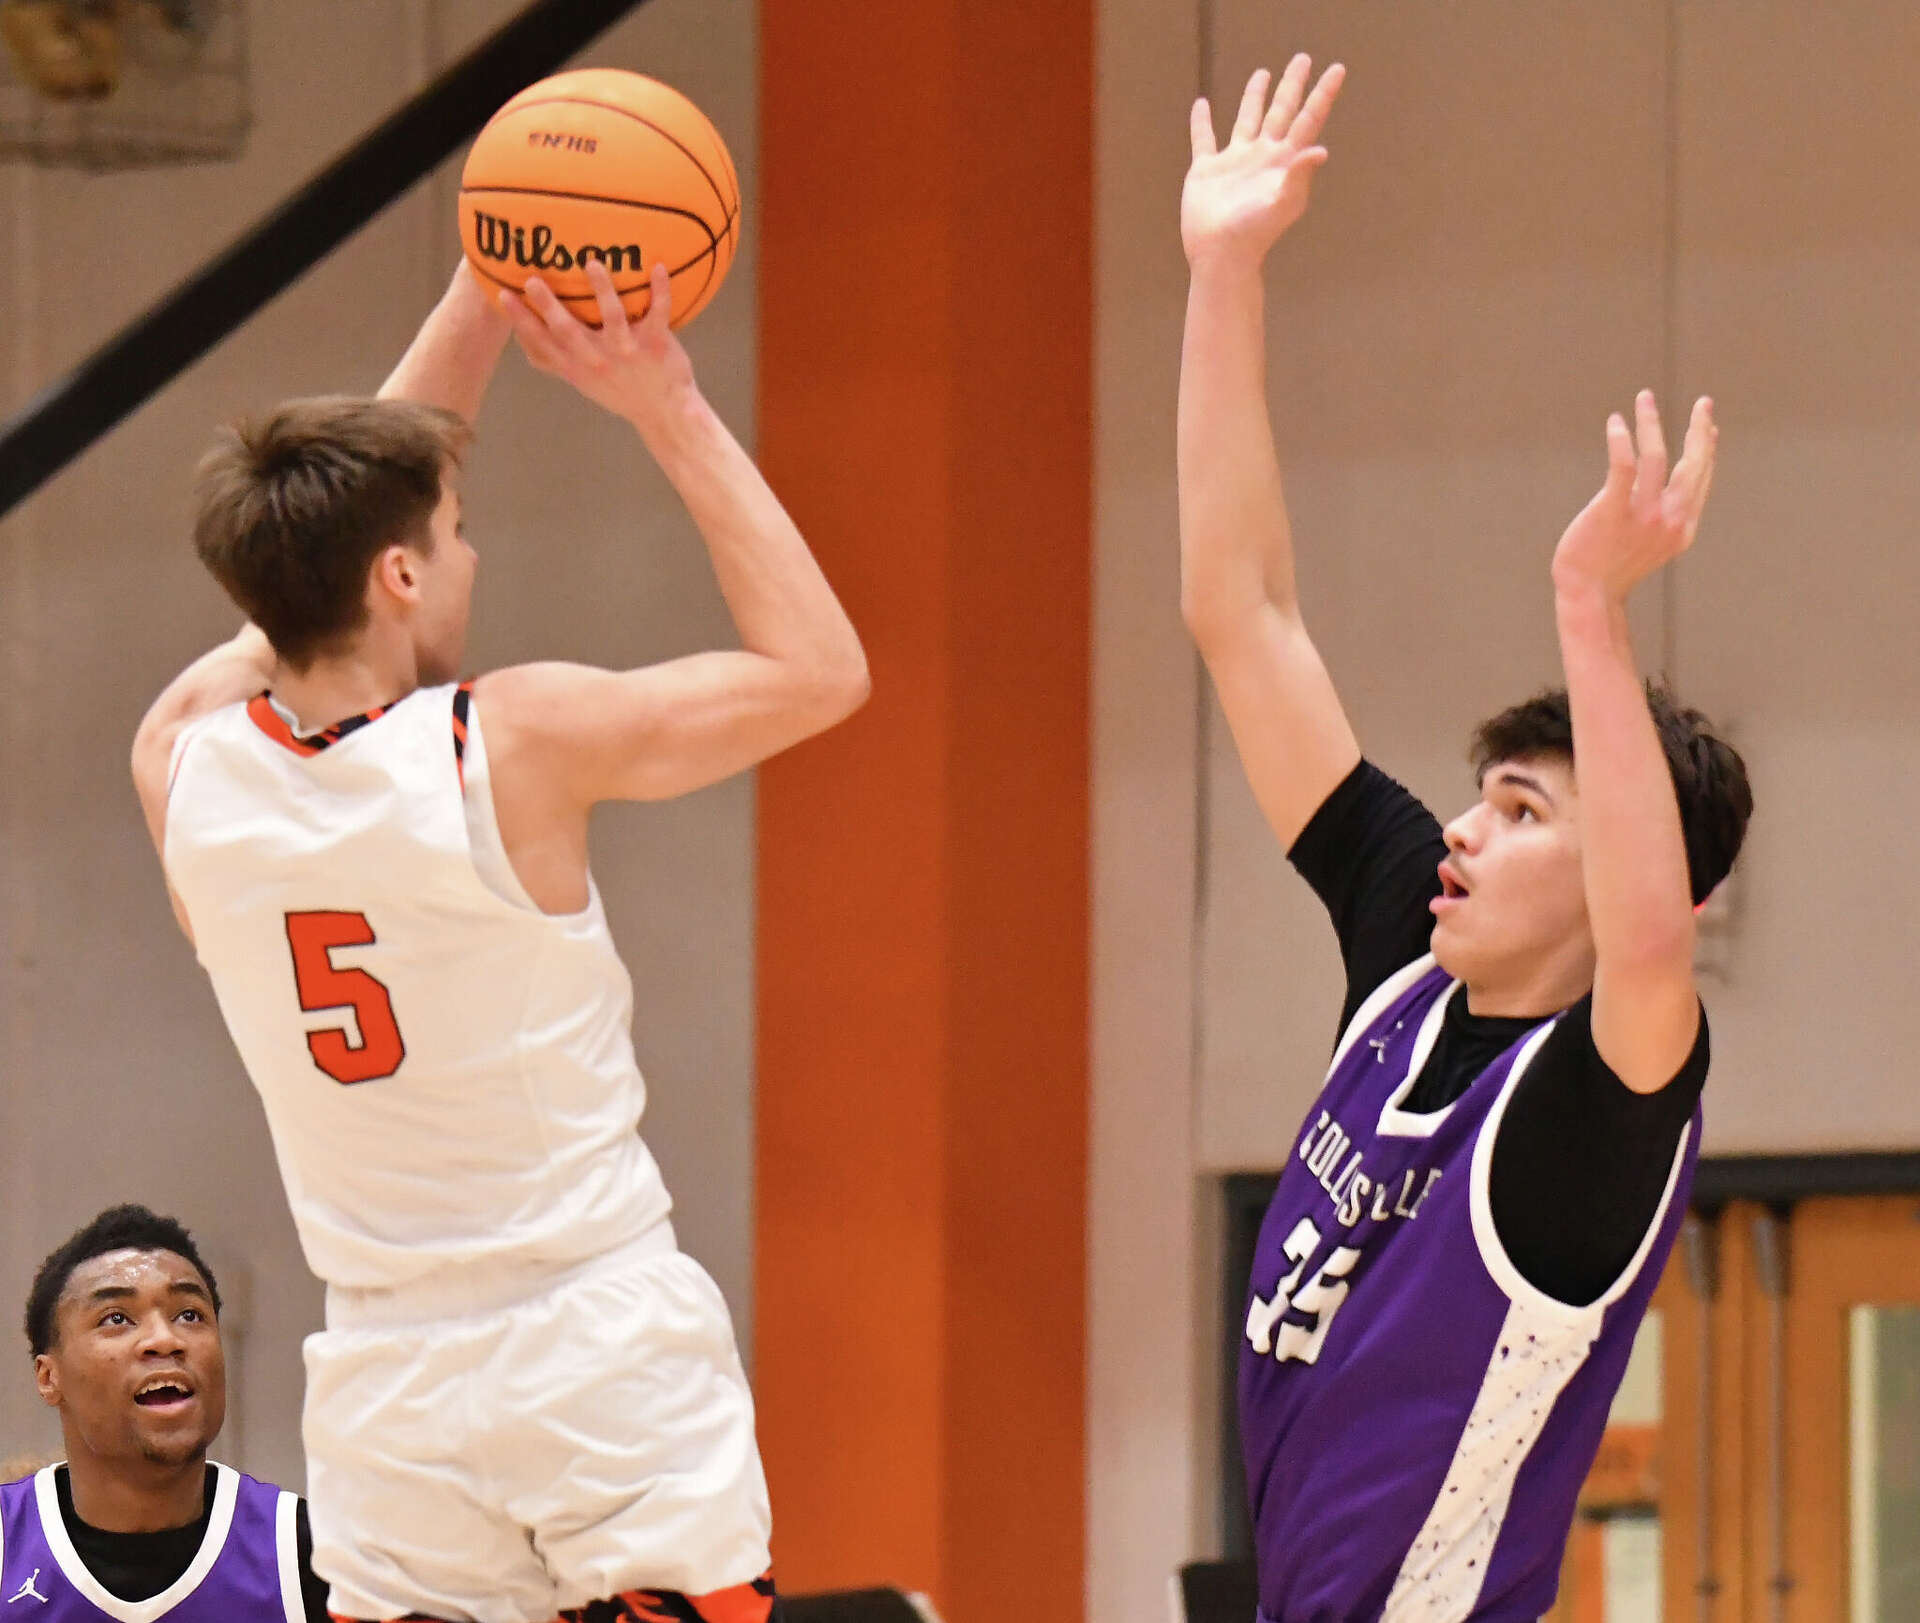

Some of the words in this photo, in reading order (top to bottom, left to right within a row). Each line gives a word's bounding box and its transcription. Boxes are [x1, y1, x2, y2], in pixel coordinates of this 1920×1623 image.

[474, 209, 642, 272] Wilson
[284, 910, 405, 1085] 5
[1245, 1217, 1362, 1365] 35
